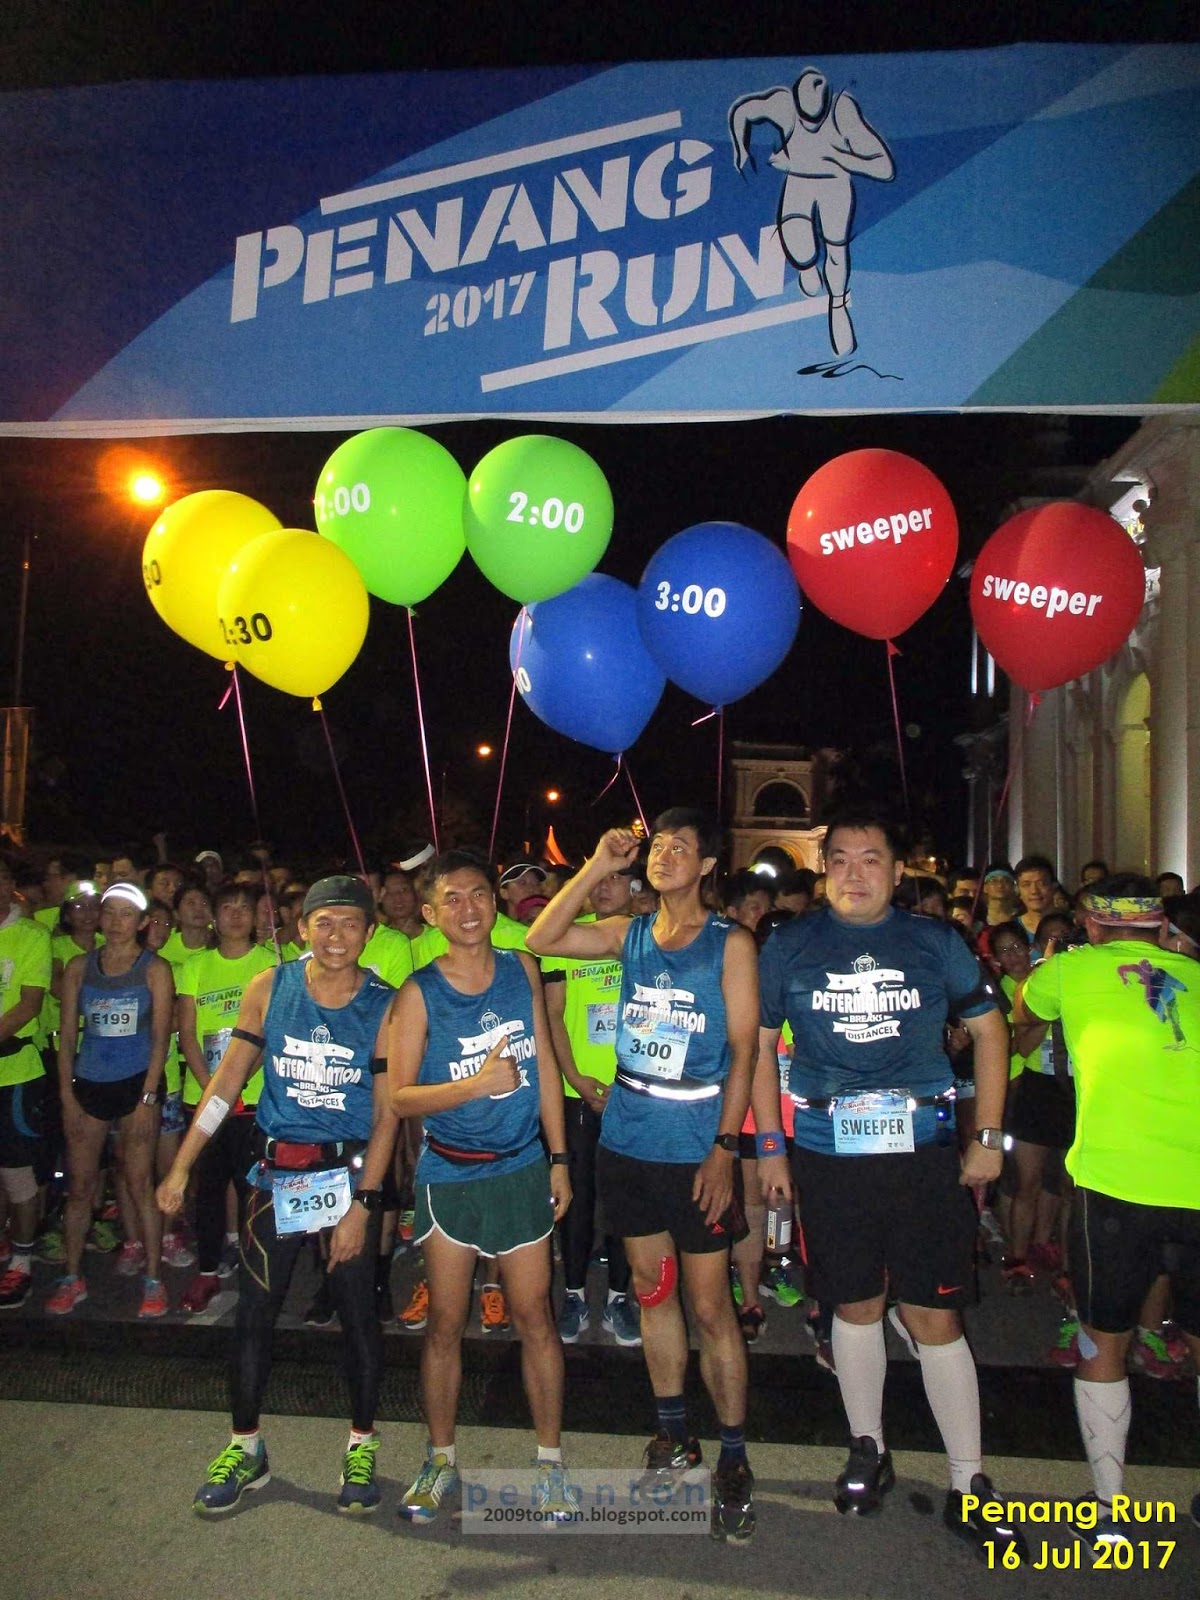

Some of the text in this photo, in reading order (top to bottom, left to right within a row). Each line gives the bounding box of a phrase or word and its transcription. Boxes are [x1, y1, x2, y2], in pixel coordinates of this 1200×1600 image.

[230, 139, 714, 323] PENANG
[424, 225, 786, 351] 2017 RUN
[506, 490, 585, 534] 2:00
[819, 506, 933, 556] sweeper
[654, 580, 727, 618] 3:00
[982, 574, 1103, 619] sweeper
[603, 974, 622, 986] RU
[223, 1000, 241, 1012] RU
[812, 988, 921, 1014] DETERMNATION
[91, 1013, 131, 1026] E199
[847, 1026, 893, 1040] DISTANCES
[629, 1038, 672, 1060] 3:00
[272, 1055, 362, 1087] DETERMNATION
[841, 1118, 905, 1136] SWEEPER
[288, 1192, 337, 1215] 2:30
